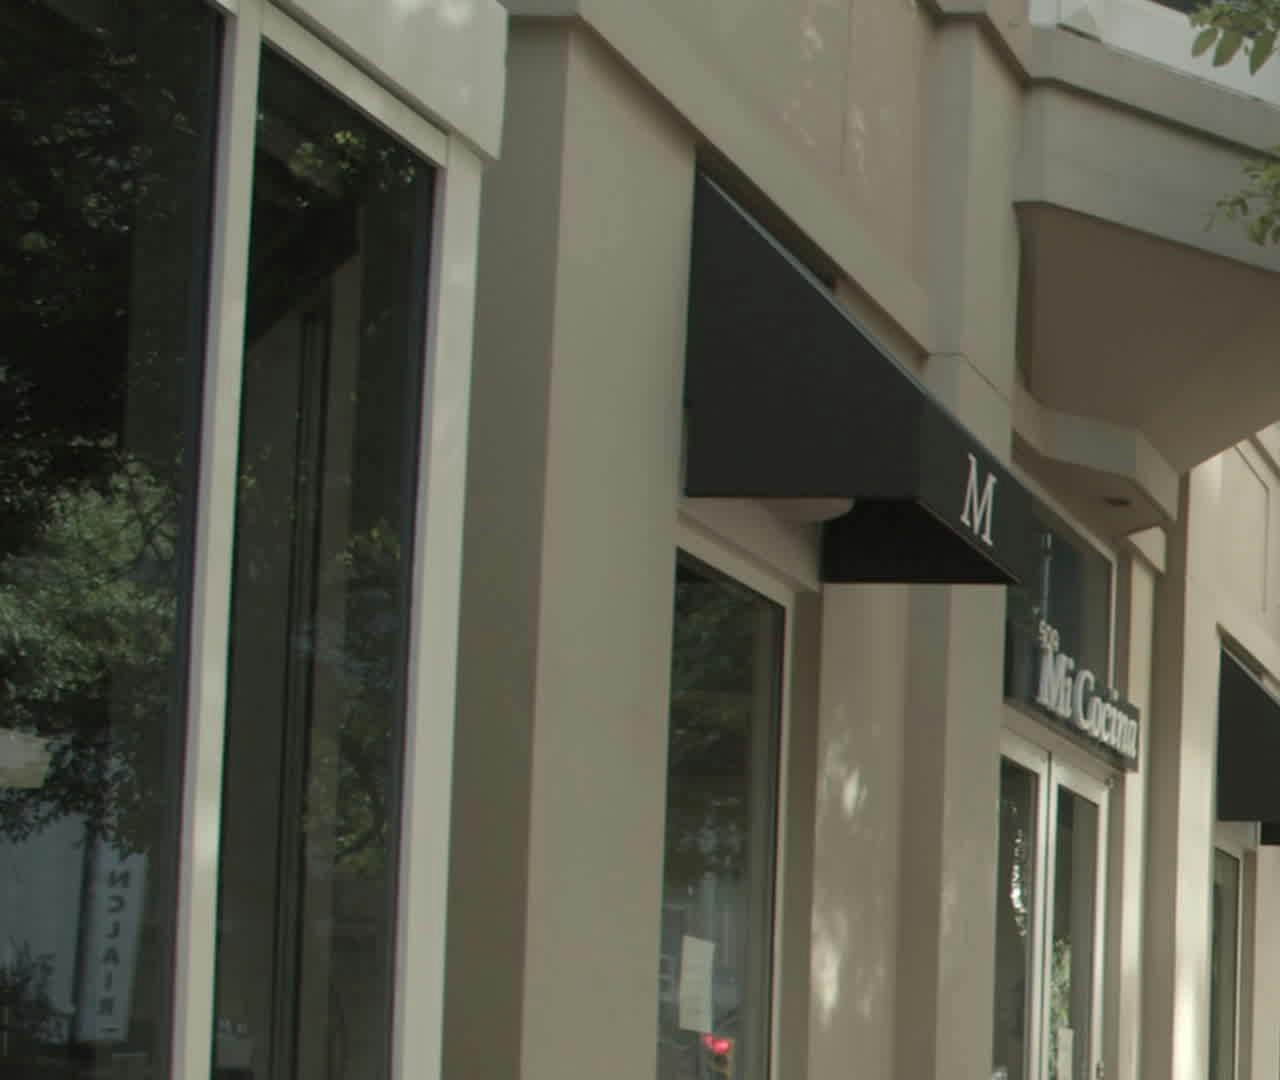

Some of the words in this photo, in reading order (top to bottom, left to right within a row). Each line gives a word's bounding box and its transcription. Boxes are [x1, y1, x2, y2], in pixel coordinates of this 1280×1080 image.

[960, 451, 997, 546] M
[1037, 652, 1074, 718] Mi
[1074, 669, 1138, 759] Cocina
